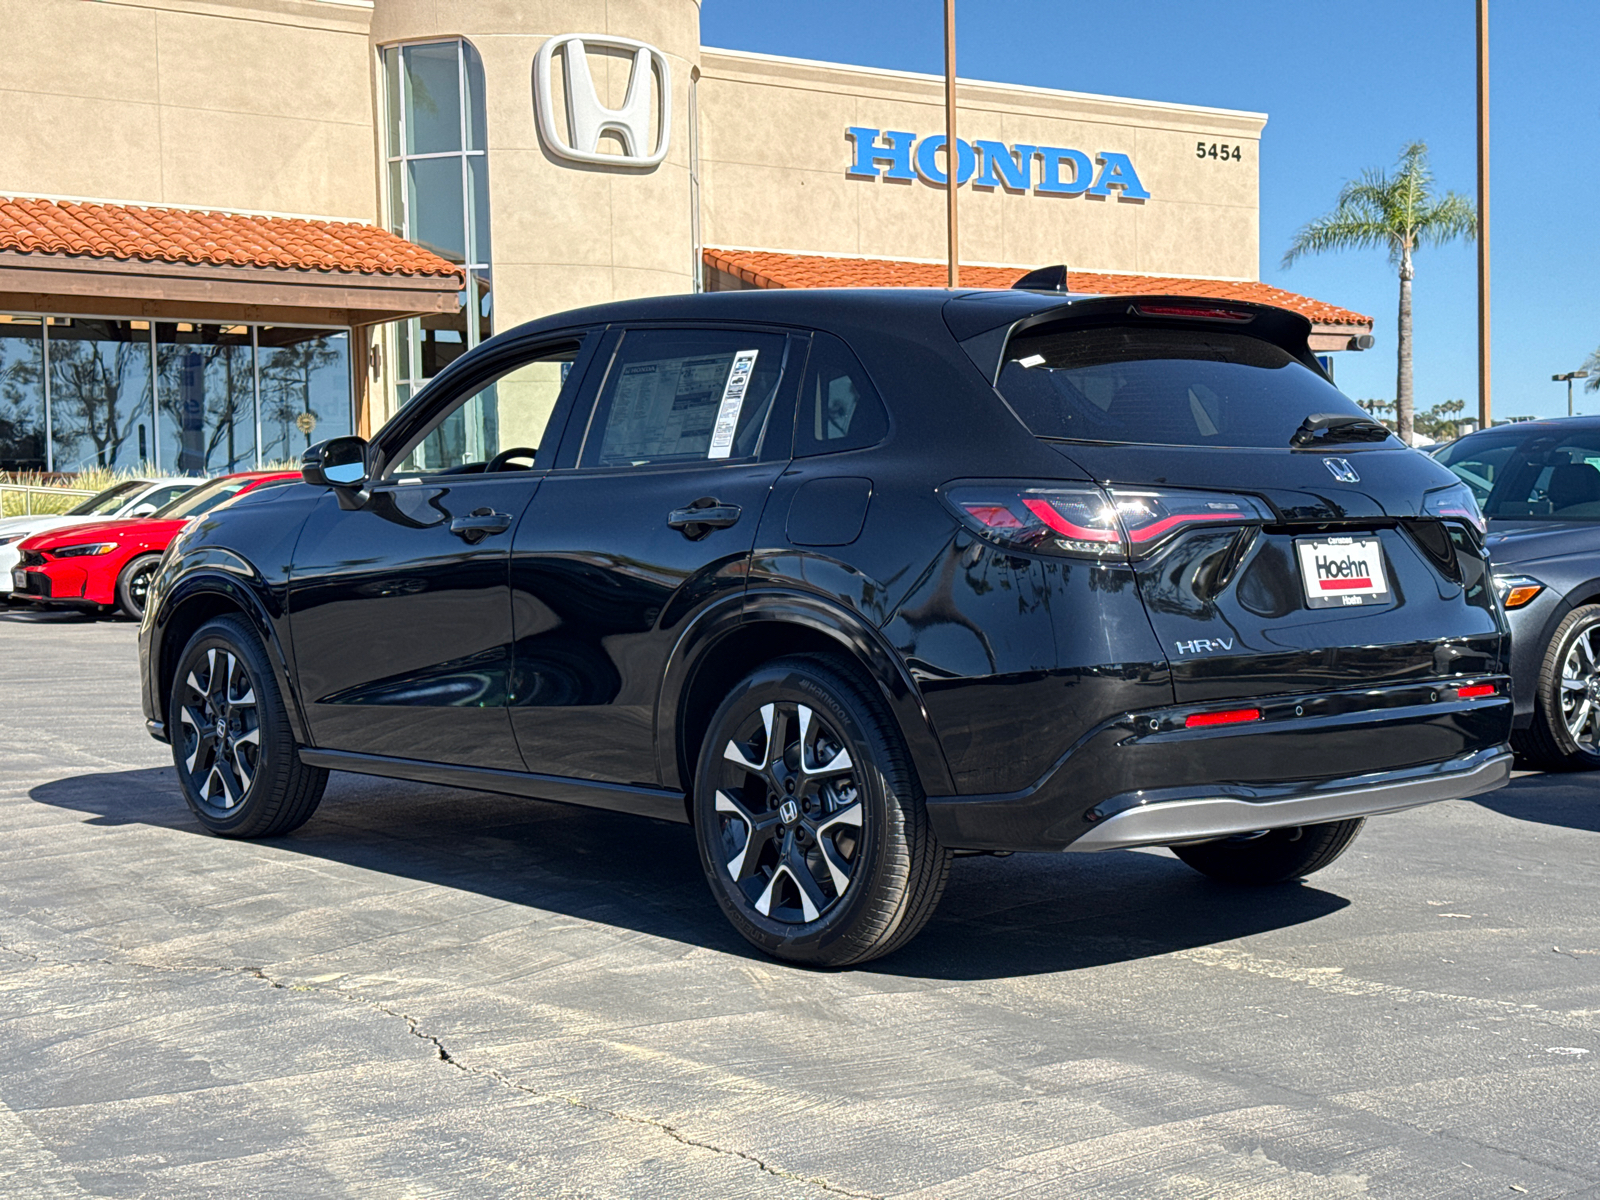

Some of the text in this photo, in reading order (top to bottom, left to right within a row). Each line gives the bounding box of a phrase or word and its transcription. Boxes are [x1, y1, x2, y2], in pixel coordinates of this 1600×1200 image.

[1196, 141, 1242, 163] 5454
[845, 126, 1151, 204] HONDA
[1315, 555, 1370, 579] Hoehn
[1342, 595, 1363, 606] Hoehn
[1176, 637, 1234, 655] HR-V
